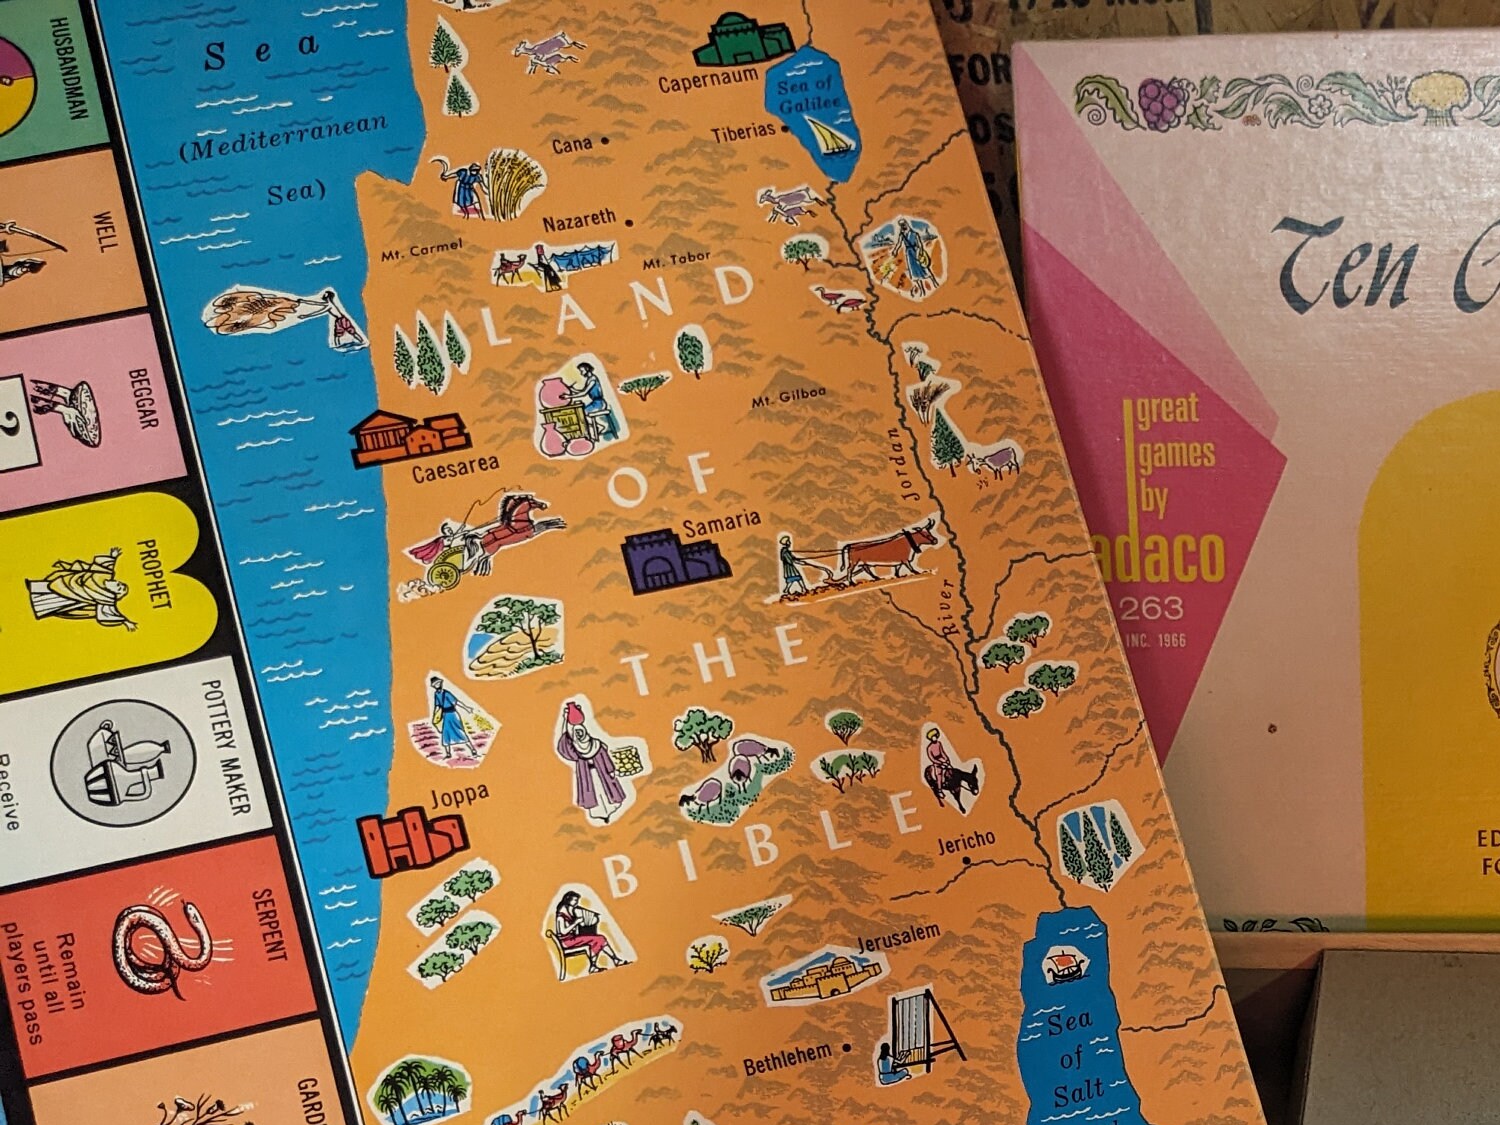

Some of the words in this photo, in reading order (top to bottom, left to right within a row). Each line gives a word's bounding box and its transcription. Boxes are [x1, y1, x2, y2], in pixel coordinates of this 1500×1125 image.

[50, 17, 88, 120] HUSBANDMAN
[658, 66, 759, 94] Capernaum
[778, 81, 808, 95] Sea
[816, 75, 832, 90] of
[780, 97, 840, 114] Galilee
[179, 115, 388, 165] (Mediterranean
[553, 135, 593, 155] Cana
[710, 123, 776, 144] Tiberias
[267, 179, 326, 206] Sea)
[93, 211, 119, 253] WELL
[543, 209, 616, 233] Nazareth
[381, 248, 405, 263] Mt.
[410, 238, 464, 258] Carmel
[643, 255, 667, 270] Mt.
[672, 250, 711, 265] Tabor
[1271, 214, 1419, 315] Ten
[481, 266, 754, 346] LAND
[128, 367, 160, 430] BEGGAR
[752, 396, 776, 409] Mt.
[780, 387, 827, 405] Gilboa
[1136, 392, 1199, 431] great
[412, 454, 500, 484] Caesarea
[888, 427, 921, 501] Jordan
[1139, 442, 1216, 475] games
[607, 451, 715, 508] OF
[1140, 478, 1168, 520] by
[683, 508, 762, 539] Samaria
[136, 538, 172, 610] PROPHET
[940, 578, 961, 637] River
[1120, 596, 1184, 620] 263
[1158, 633, 1186, 647] 1966
[620, 623, 808, 697] THE
[201, 679, 236, 750] POTTERY
[219, 757, 252, 817] MAKER
[0, 754, 19, 830] Receive
[431, 782, 489, 810] Joppa
[602, 790, 922, 899] BIBLE
[938, 829, 996, 857] Jericho
[252, 887, 288, 962] SERPENT
[857, 920, 940, 954] Jerusalem
[1, 922, 31, 993] players
[19, 1000, 43, 1046] pass
[33, 940, 57, 984] until
[45, 991, 65, 1014] all
[56, 932, 86, 1010] Remain
[1047, 1010, 1093, 1036] Sea
[743, 1043, 832, 1078] Bethlehem
[1060, 1049, 1084, 1071] of
[1053, 1077, 1105, 1110] Salt
